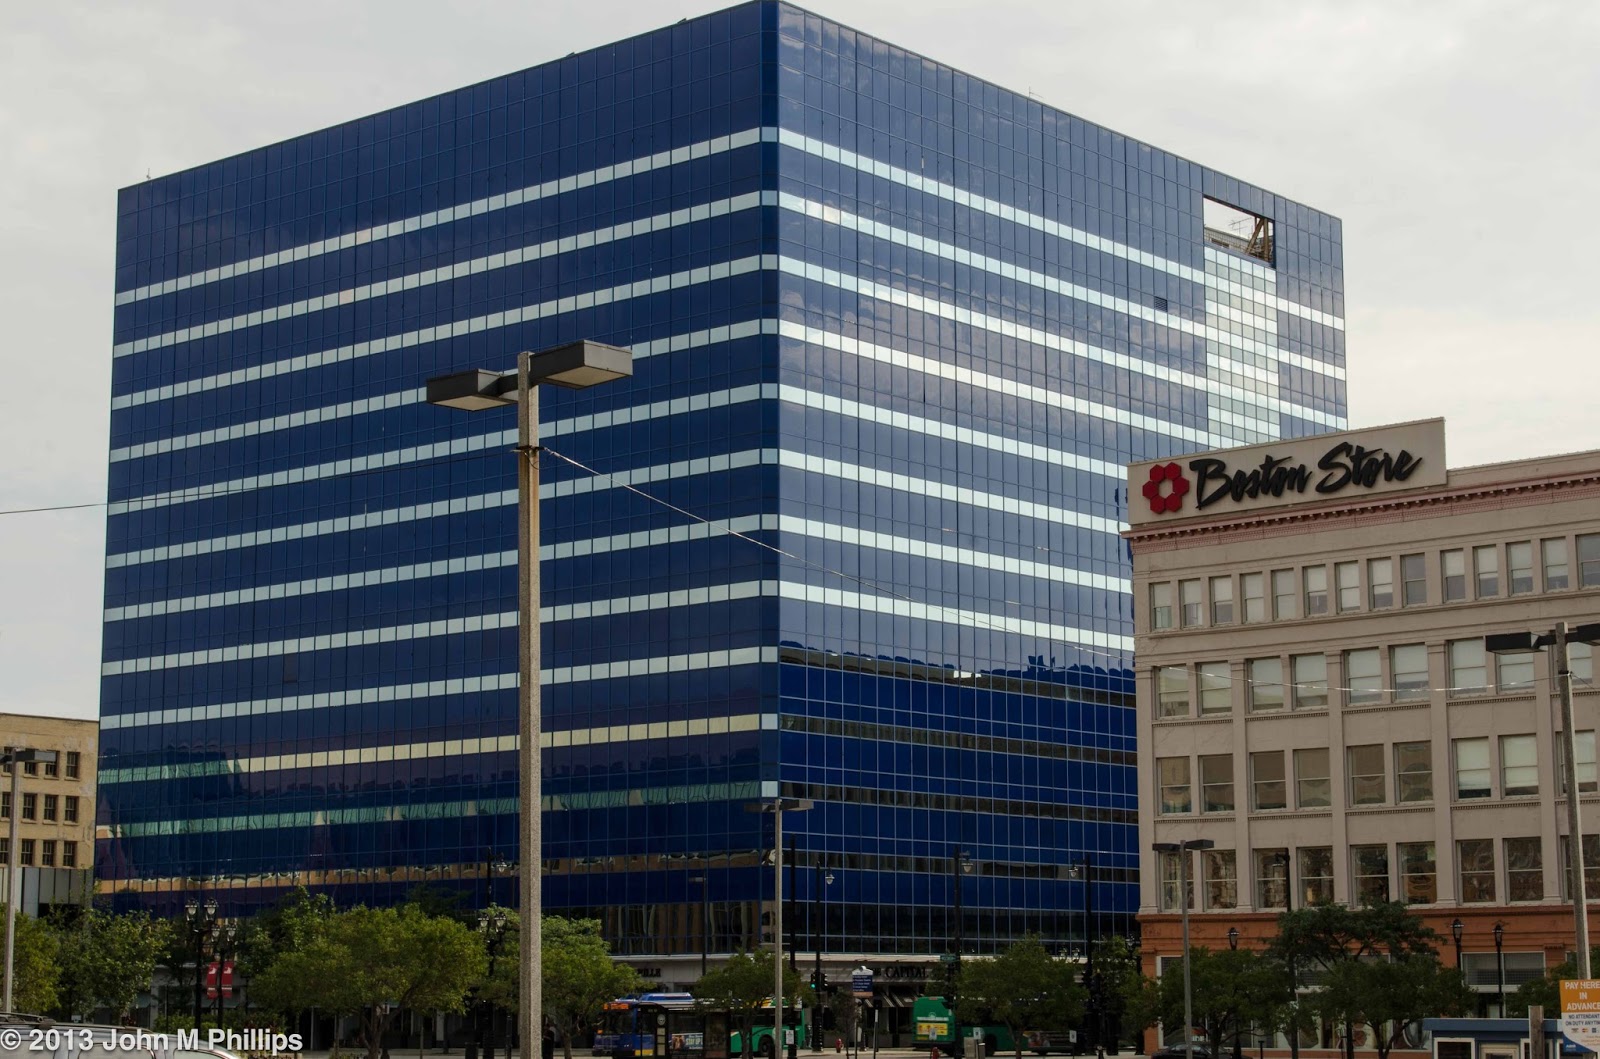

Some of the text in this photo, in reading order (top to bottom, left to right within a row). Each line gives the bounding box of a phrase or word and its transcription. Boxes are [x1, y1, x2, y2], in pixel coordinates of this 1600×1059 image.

[1189, 441, 1422, 510] Boston Store
[885, 966, 928, 978] CAPITAL
[1580, 981, 1600, 989] HERE
[1567, 1002, 1600, 1010] ADVANCE
